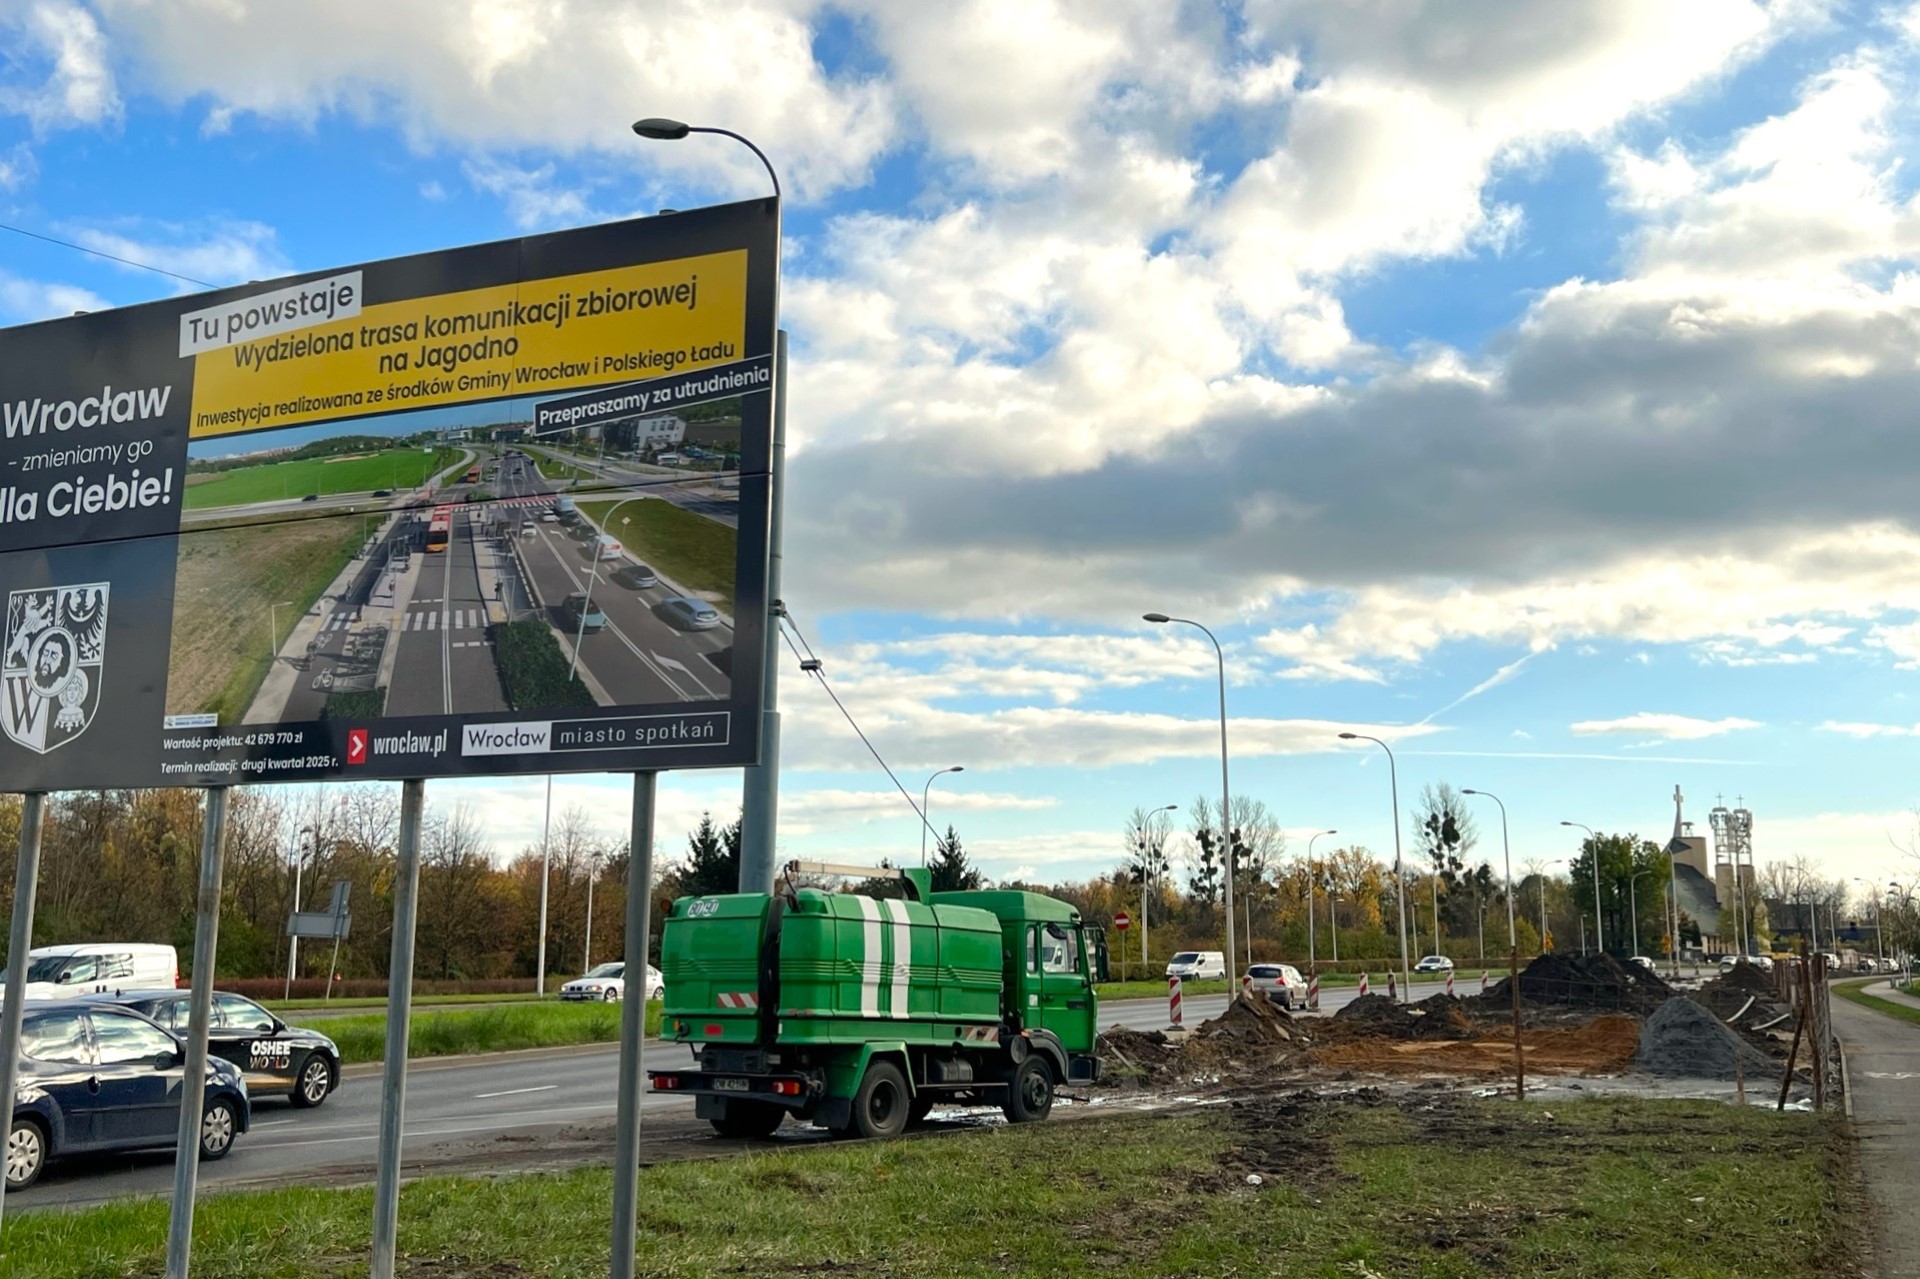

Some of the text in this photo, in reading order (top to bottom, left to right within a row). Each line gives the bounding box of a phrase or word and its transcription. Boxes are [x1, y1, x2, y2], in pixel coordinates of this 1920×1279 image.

[189, 281, 354, 344] Tu powstaje
[235, 275, 698, 372] Wydzielona trasa komunikacji zbiorowej
[379, 335, 519, 374] na Jagodno
[197, 341, 735, 428] Inwestycja realizowana ze środków Gminy Wrocław i Polskiego Ładu
[539, 365, 770, 426] Przepraszamy za utrudnienia
[3, 385, 172, 438] Wrocław
[22, 443, 124, 472] zmieniamy
[127, 440, 153, 463] go
[47, 468, 173, 517] Ciebie!
[163, 732, 303, 751] Wartość projektu: 42 679 770 zł
[373, 728, 447, 755] wroclaw.pl
[467, 725, 547, 749] Wrocław
[560, 720, 715, 745] miasto spotkań
[161, 756, 339, 775] Termin realizacji: drugi kwartał 2025 r.
[251, 1040, 291, 1056] OSHEE
